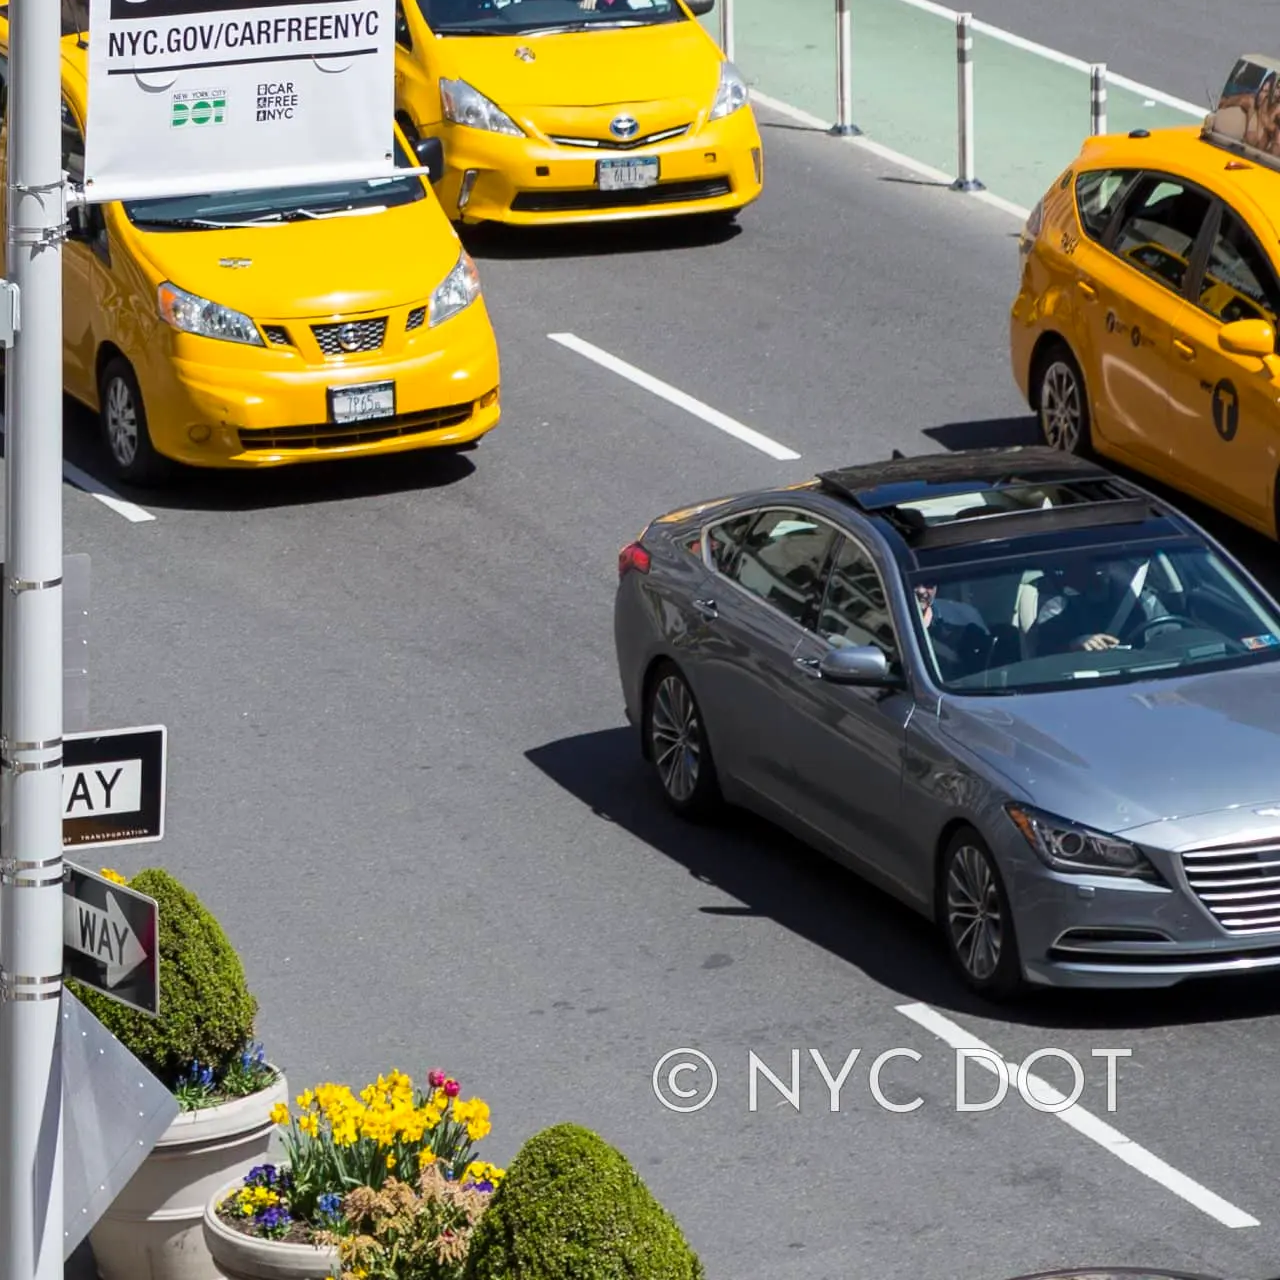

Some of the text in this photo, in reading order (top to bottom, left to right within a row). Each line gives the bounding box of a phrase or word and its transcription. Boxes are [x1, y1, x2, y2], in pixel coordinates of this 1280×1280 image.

[108, 10, 380, 58] NYC.GOV/CARFREENYC
[192, 91, 209, 99] YORK
[211, 89, 226, 97] CITY
[267, 82, 294, 95] CAR
[267, 94, 298, 107] FREE
[172, 99, 226, 127] DOT
[266, 107, 294, 121] NYC
[63, 767, 124, 813] AY
[79, 906, 130, 967] WAY
